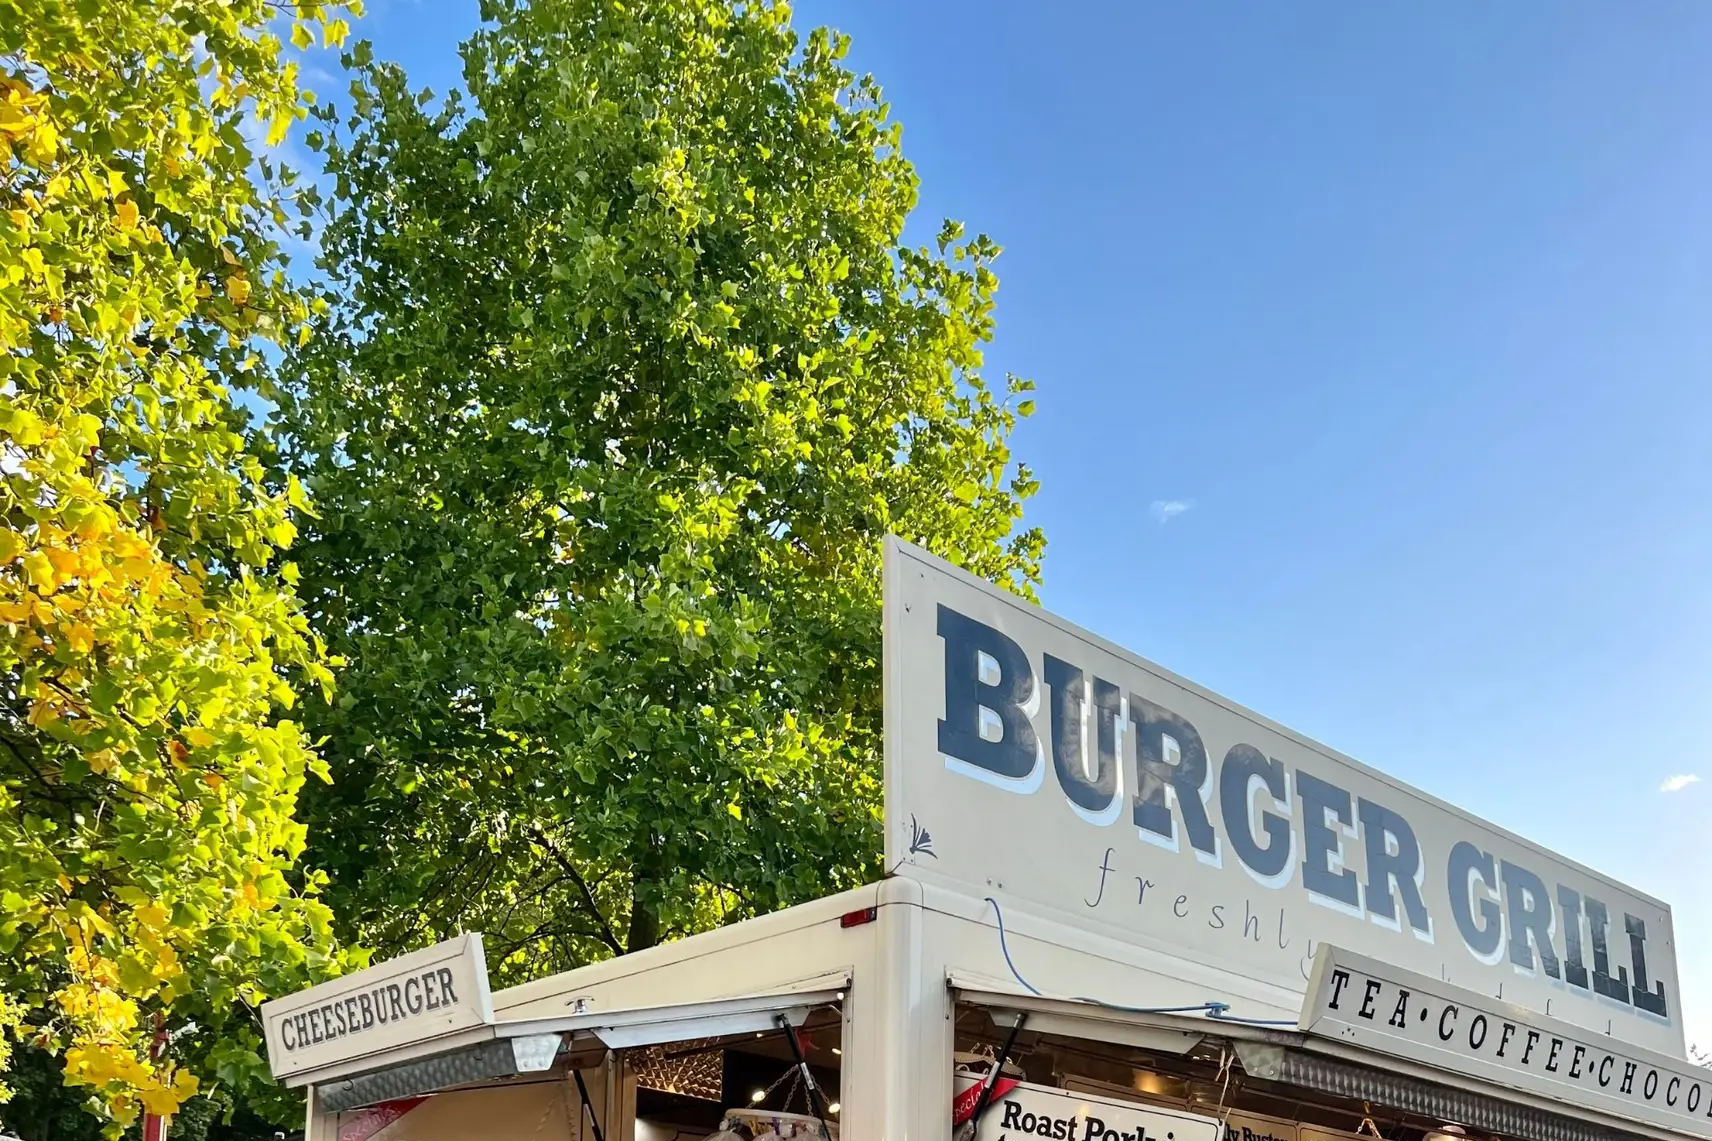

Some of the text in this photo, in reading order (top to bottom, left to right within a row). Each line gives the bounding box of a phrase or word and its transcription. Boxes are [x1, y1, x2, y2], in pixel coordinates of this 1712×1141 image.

[936, 601, 1670, 1022] BURGER GRILL
[281, 967, 458, 1051] CHEESEBURGER
[1328, 969, 1410, 1028] TEA
[1438, 1004, 1586, 1080] COFFEE
[1598, 1055, 1712, 1118] CHOCO
